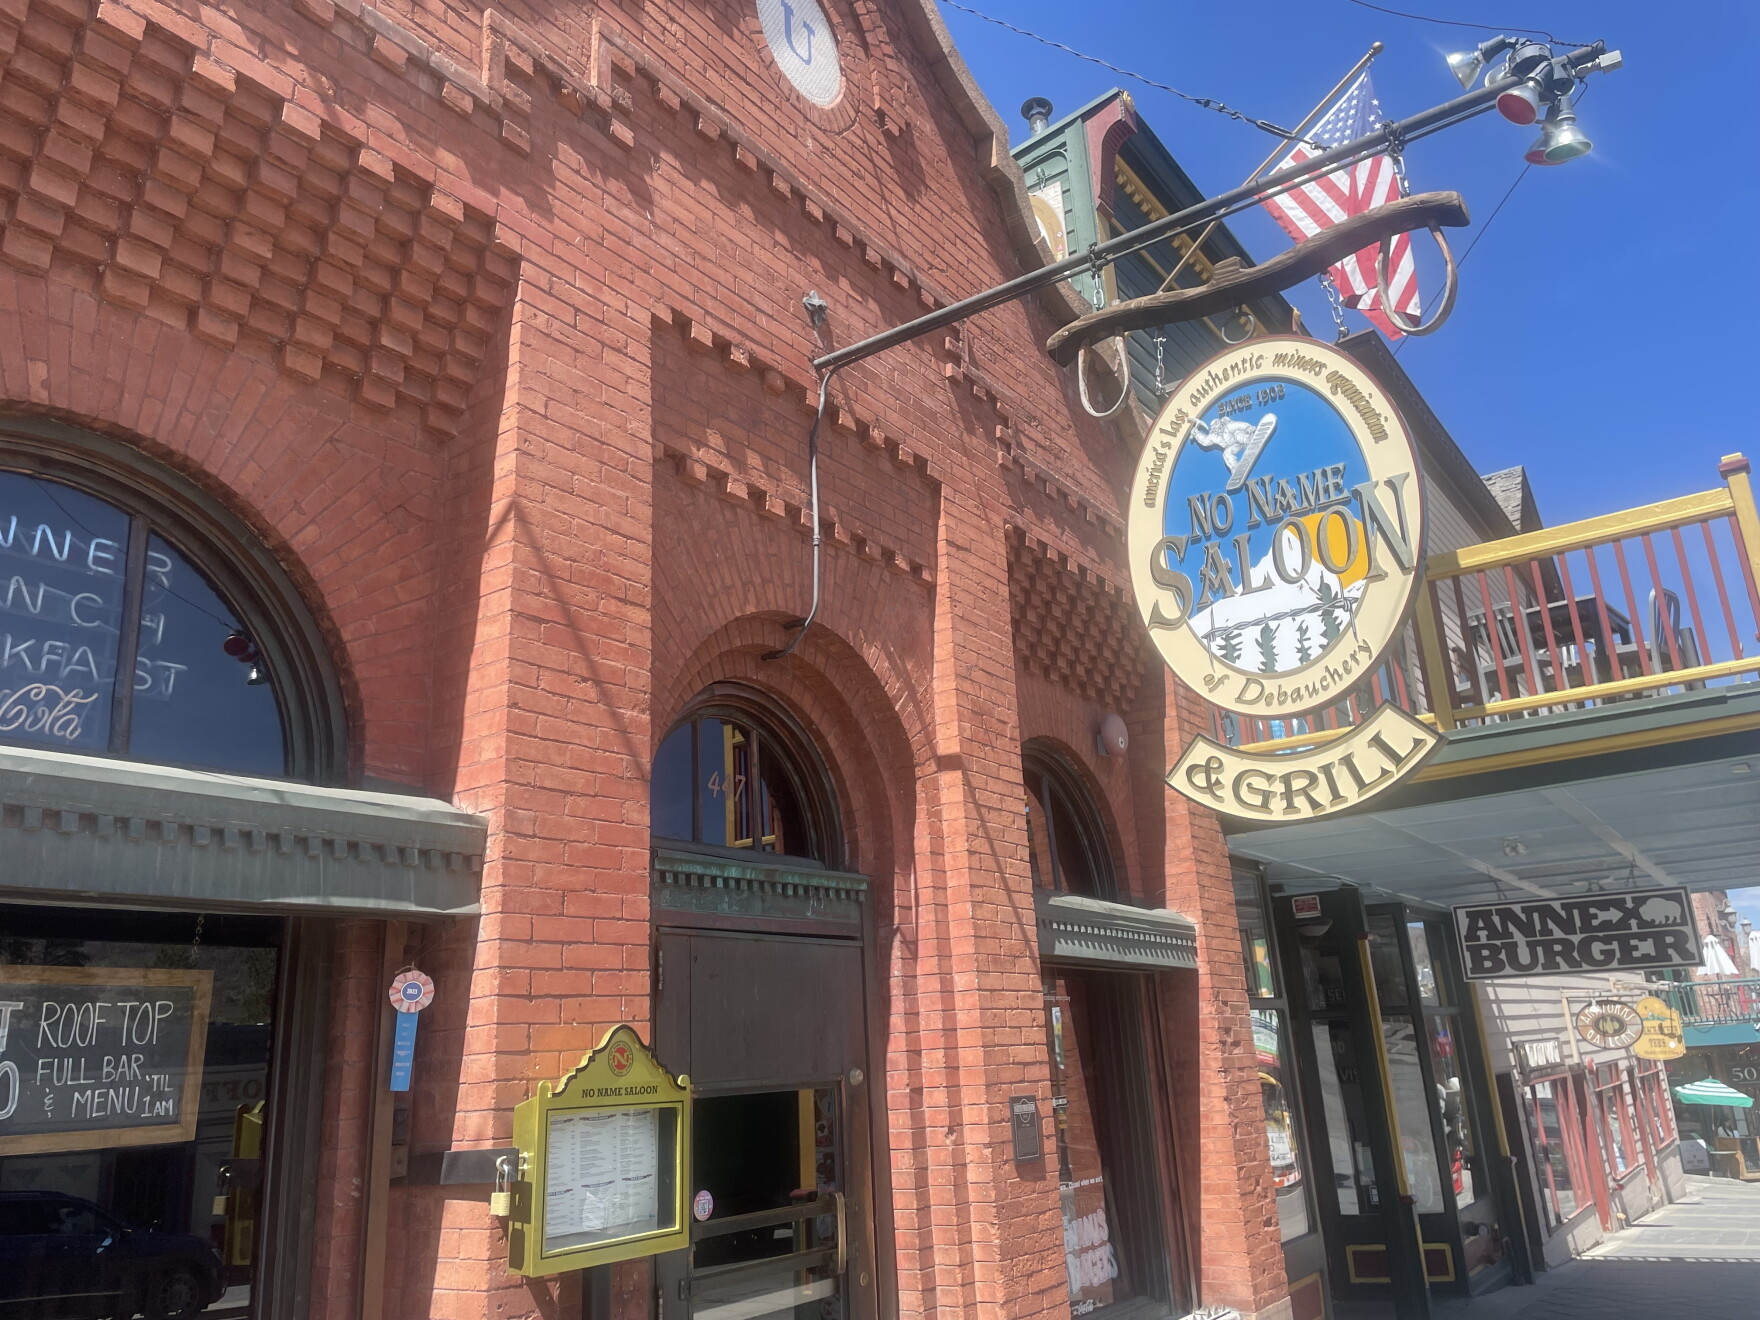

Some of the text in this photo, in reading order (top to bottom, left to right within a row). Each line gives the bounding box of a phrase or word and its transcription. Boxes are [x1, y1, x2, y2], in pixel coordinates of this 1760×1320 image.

[1217, 393, 1253, 418] SINCE
[1143, 349, 1390, 509] america's last authentic miners organization
[1187, 462, 1351, 544] NO NAME
[1148, 471, 1415, 631] SALOON
[1203, 637, 1374, 707] of Debauchery
[0, 683, 98, 740] Cola
[1231, 729, 1428, 816] GRILL
[1464, 896, 1650, 943] ANNEX
[1466, 929, 1696, 975] BURGER
[1587, 1029, 1636, 1048] GALERY
[36, 1057, 95, 1086] FULL
[102, 1054, 144, 1083] BAR
[581, 1085, 658, 1099] NO NAME SALOON
[1732, 1067, 1760, 1081] 50
[71, 1086, 140, 1118] MENU
[141, 1096, 173, 1118] 1AM
